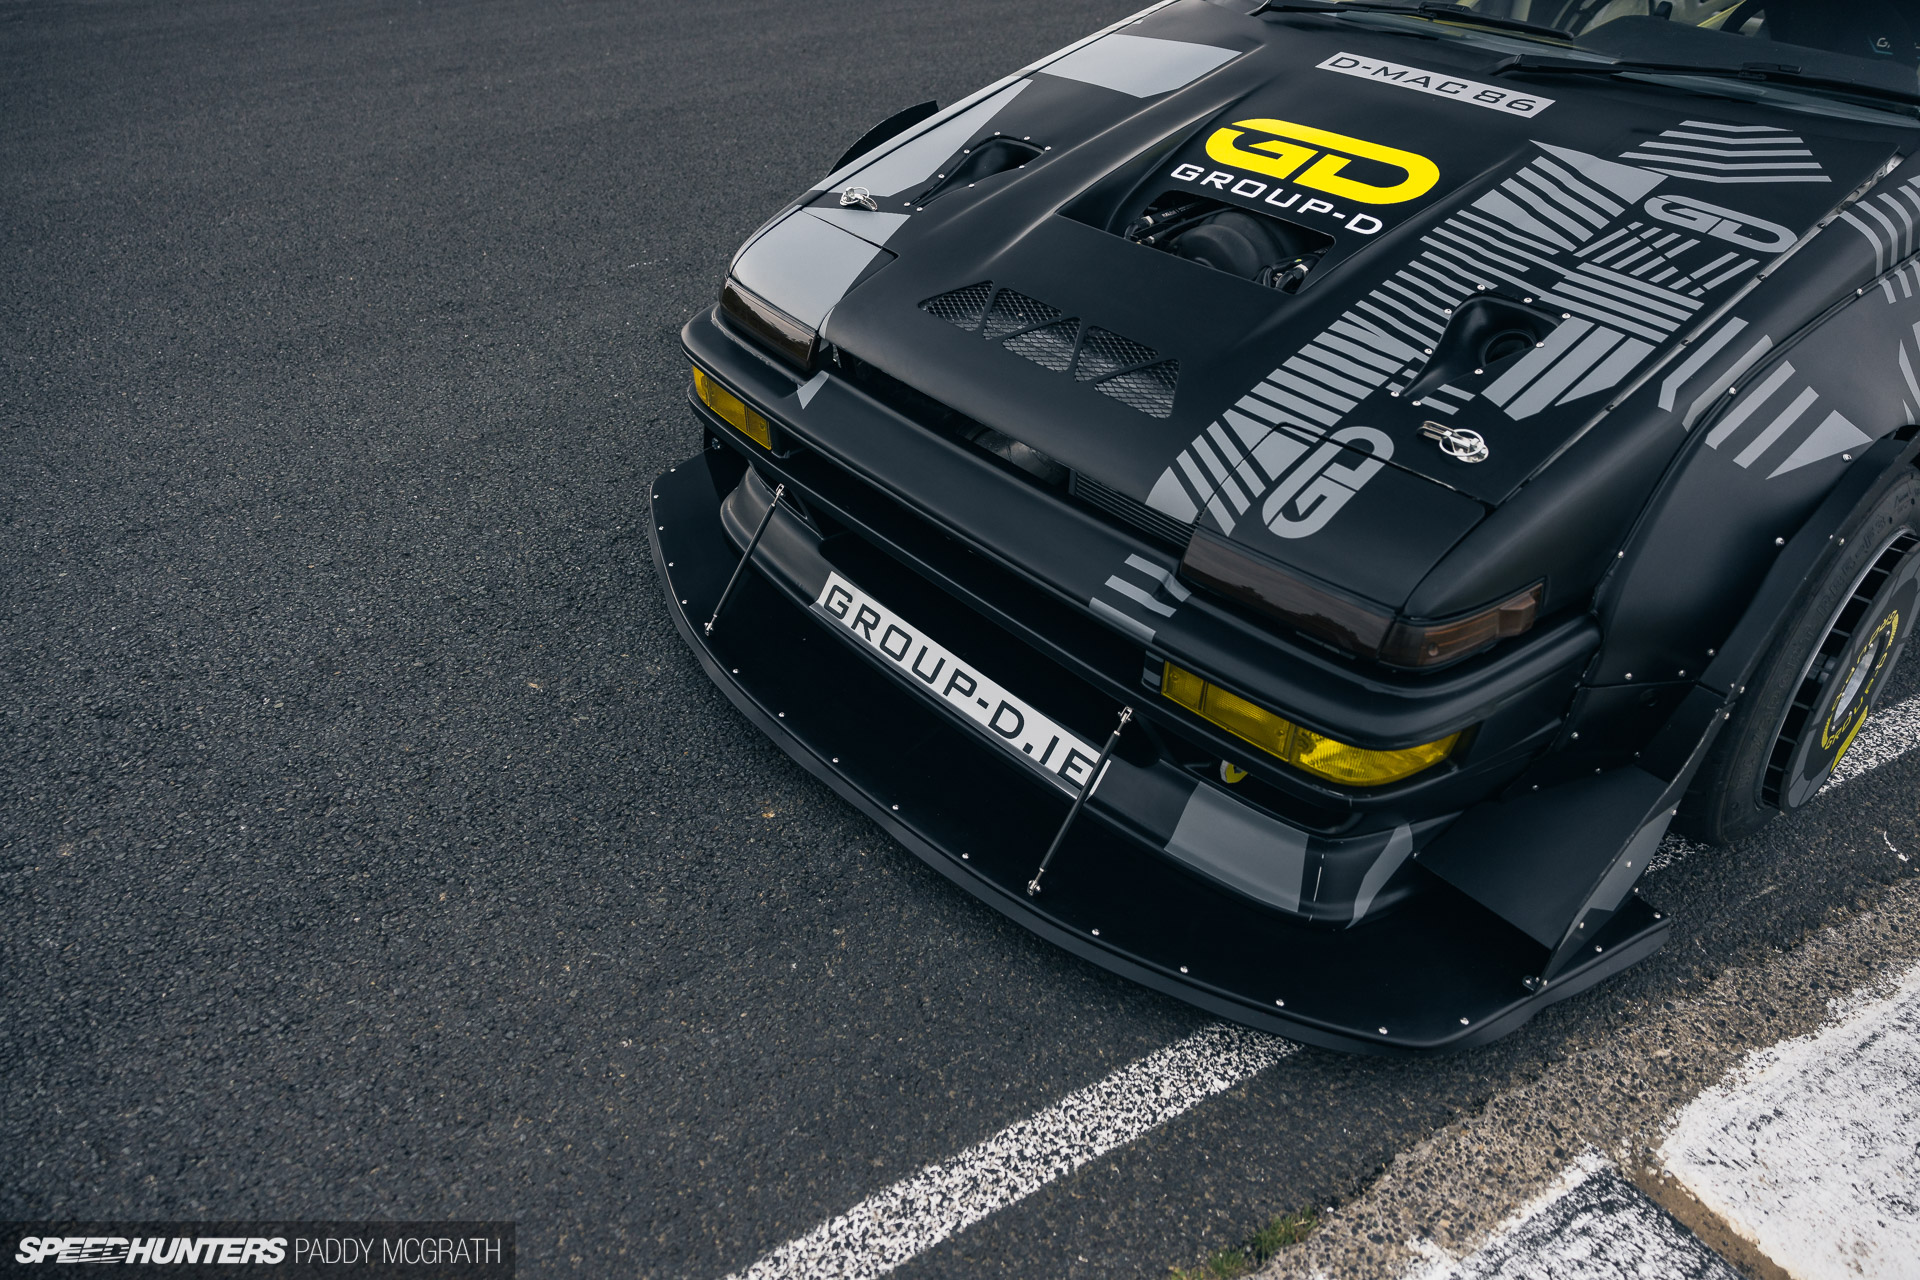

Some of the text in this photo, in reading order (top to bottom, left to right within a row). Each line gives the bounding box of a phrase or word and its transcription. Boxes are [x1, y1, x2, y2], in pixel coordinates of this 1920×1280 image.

[1328, 56, 1537, 112] D-MAC 86
[1170, 163, 1383, 234] GROUP-D
[1205, 118, 1441, 205] GD
[1643, 195, 1798, 254] GD
[1262, 425, 1395, 539] GD
[823, 584, 1097, 790] GROUP-D.IE
